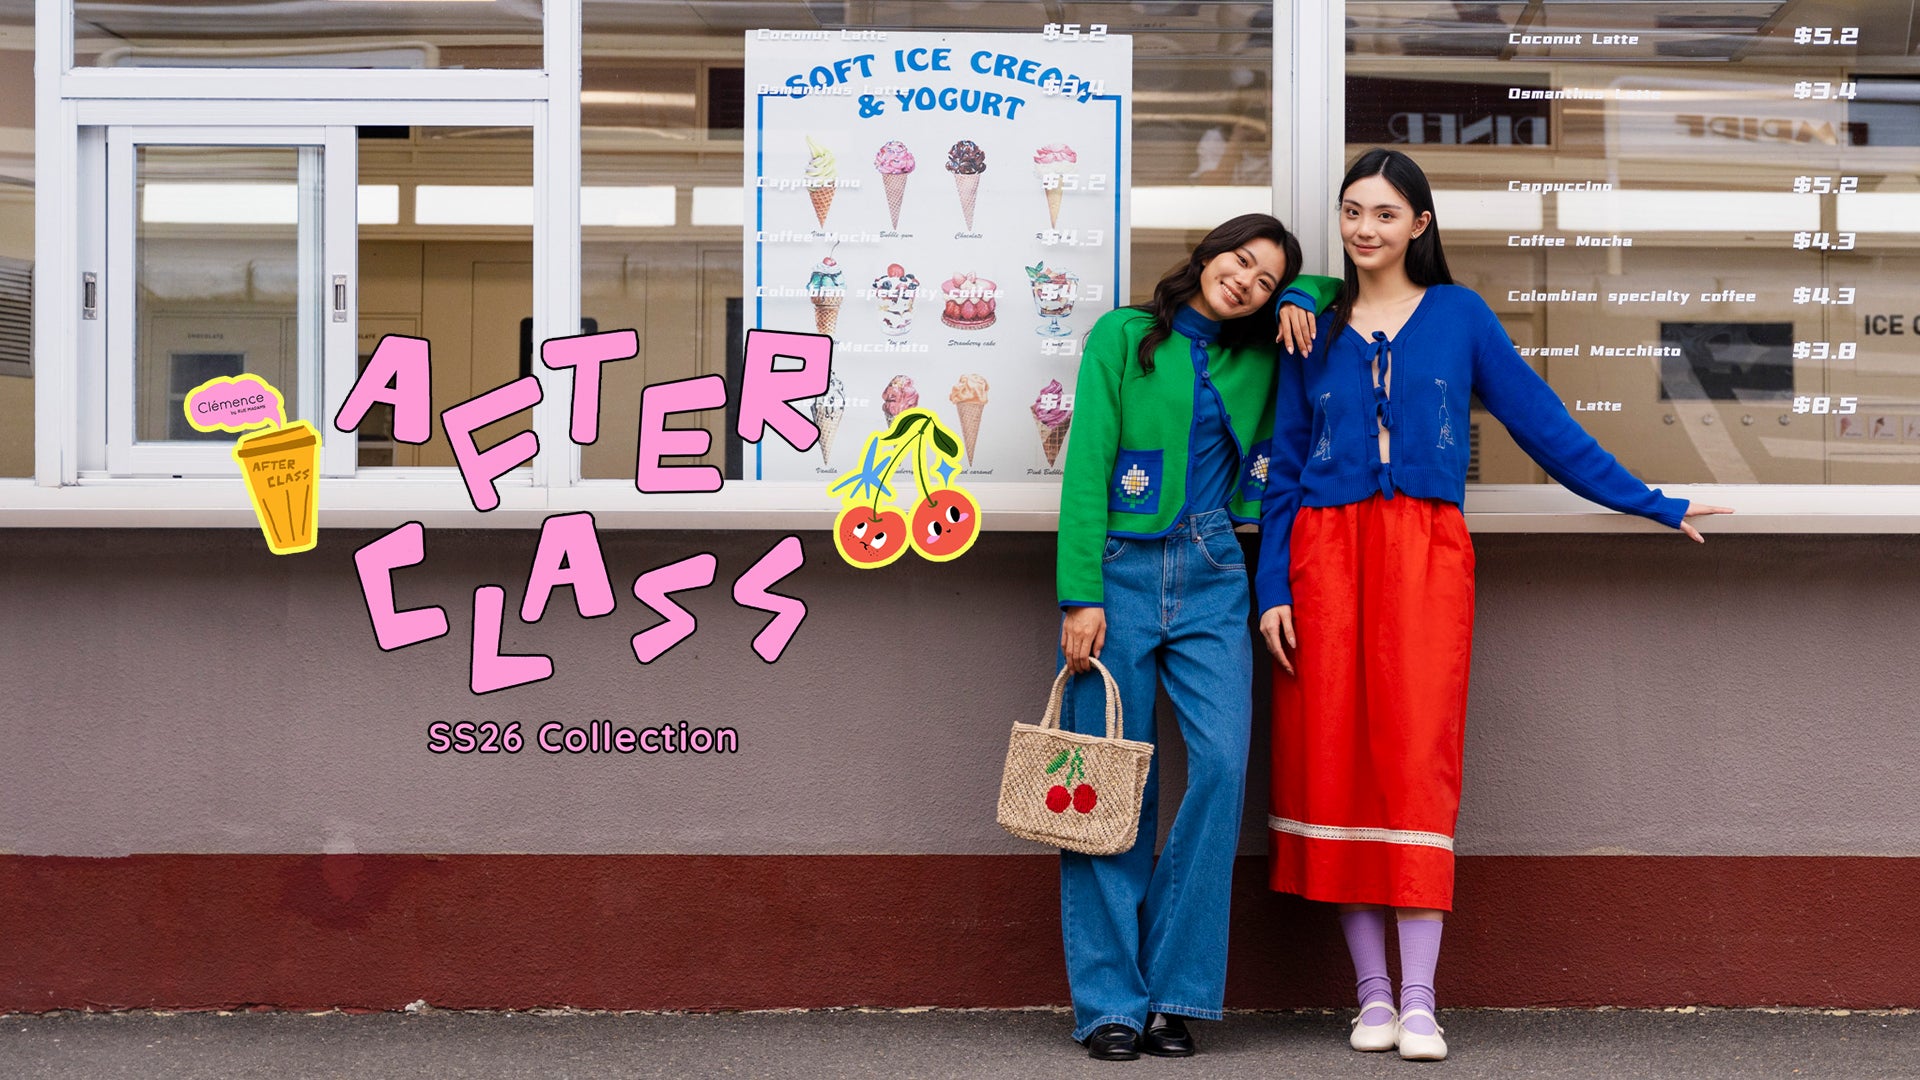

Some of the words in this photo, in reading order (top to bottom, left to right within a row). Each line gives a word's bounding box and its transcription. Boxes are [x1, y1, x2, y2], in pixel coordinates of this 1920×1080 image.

[757, 28, 831, 41] Coconut
[840, 29, 888, 41] Latte
[1042, 22, 1108, 42] $5.2
[1508, 33, 1582, 45] Coconut
[1591, 33, 1639, 45] Latte
[1793, 26, 1859, 45] $5.2
[785, 54, 875, 99] SOFT
[895, 47, 953, 73] ICE
[757, 83, 852, 96] Osmanthus
[863, 84, 910, 96] Latte
[1042, 78, 1106, 97] $3.4
[1508, 87, 1603, 100] Osmanthus
[1615, 88, 1661, 100] Latte
[1793, 81, 1857, 100] $3.4
[858, 94, 885, 119] &
[895, 87, 1026, 120] YOGURT
[756, 176, 861, 191] Cappuccino
[1042, 173, 1106, 191] $5.2
[1507, 180, 1613, 195] Cappuccino
[1793, 176, 1859, 194] $5.2
[756, 231, 814, 243] Coffee
[824, 231, 881, 243] Mocha
[954, 232, 984, 240] Chocolate
[1041, 229, 1104, 247] $4.3
[1507, 234, 1566, 247] Coffee
[1575, 234, 1633, 247] Mocha
[1792, 231, 1856, 250] $4.3
[756, 285, 847, 298] Colombian
[948, 287, 1005, 299] coffee
[1040, 283, 1104, 301] $4.3
[1507, 290, 1598, 302] Colombian
[1607, 290, 1690, 305] specialty
[1700, 290, 1757, 302] coffee
[1792, 286, 1856, 305] $4.3
[1864, 315, 1905, 335] ICE
[838, 341, 929, 353] Macchiato
[947, 339, 981, 347] Strawberry
[1040, 337, 1084, 356] $3.
[1513, 344, 1580, 357] aramel
[1590, 344, 1681, 357] Macchiato
[1792, 341, 1857, 359] $3.8
[1576, 400, 1622, 412] Latte
[1792, 396, 1858, 414] $8.5
[1026, 468, 1042, 476] Pink
